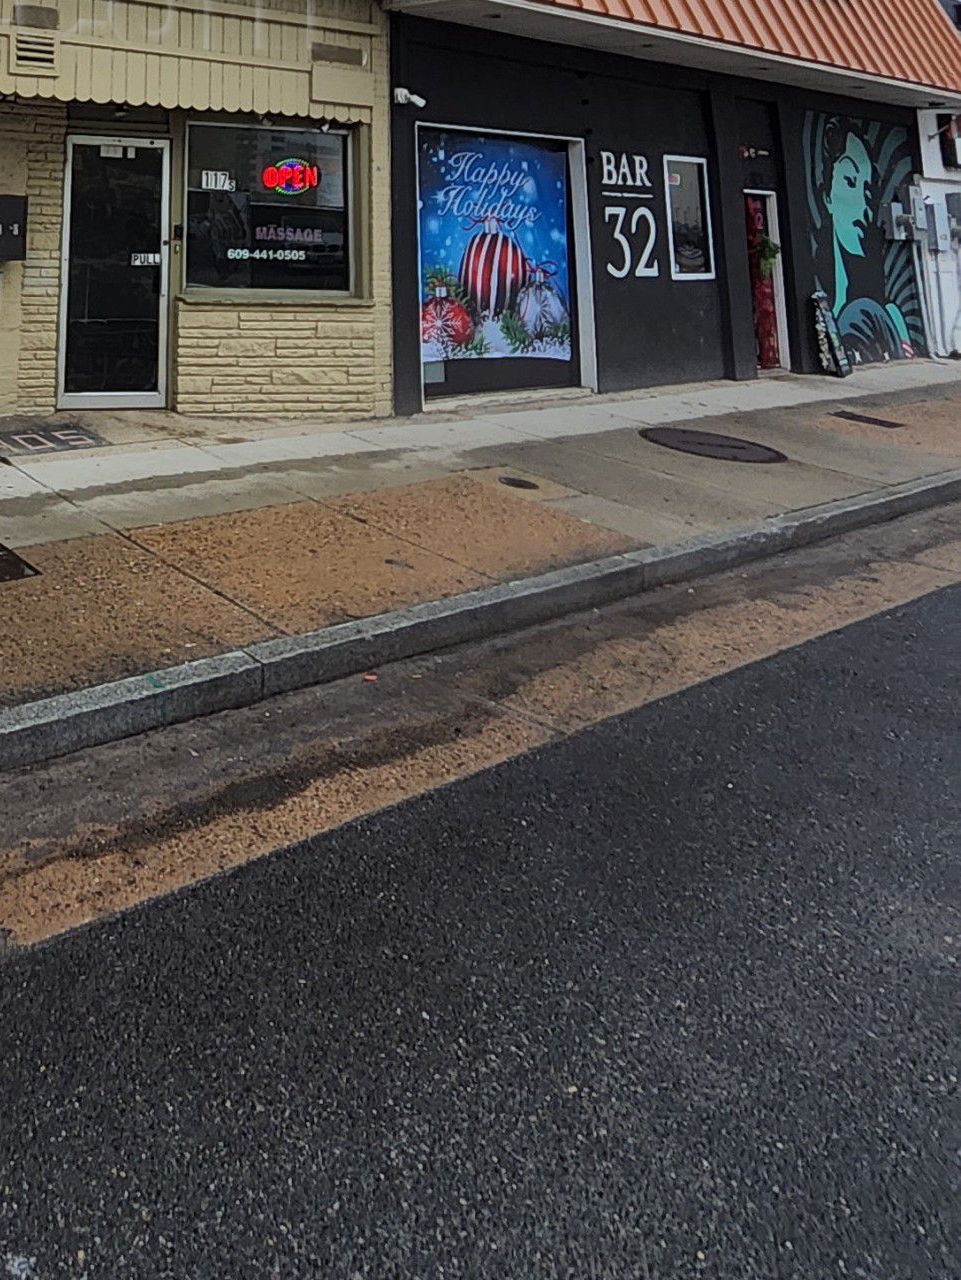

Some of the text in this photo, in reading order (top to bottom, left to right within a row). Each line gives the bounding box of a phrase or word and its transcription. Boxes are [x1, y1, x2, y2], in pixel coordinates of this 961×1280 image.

[263, 166, 318, 188] OPEN
[445, 151, 531, 200] Happy
[601, 151, 652, 187] BAR
[438, 184, 542, 229] Holidays
[255, 226, 323, 242] MASSAGE
[605, 207, 659, 278] 32
[133, 254, 160, 265] PULL
[227, 248, 306, 261] 609-441-0505
